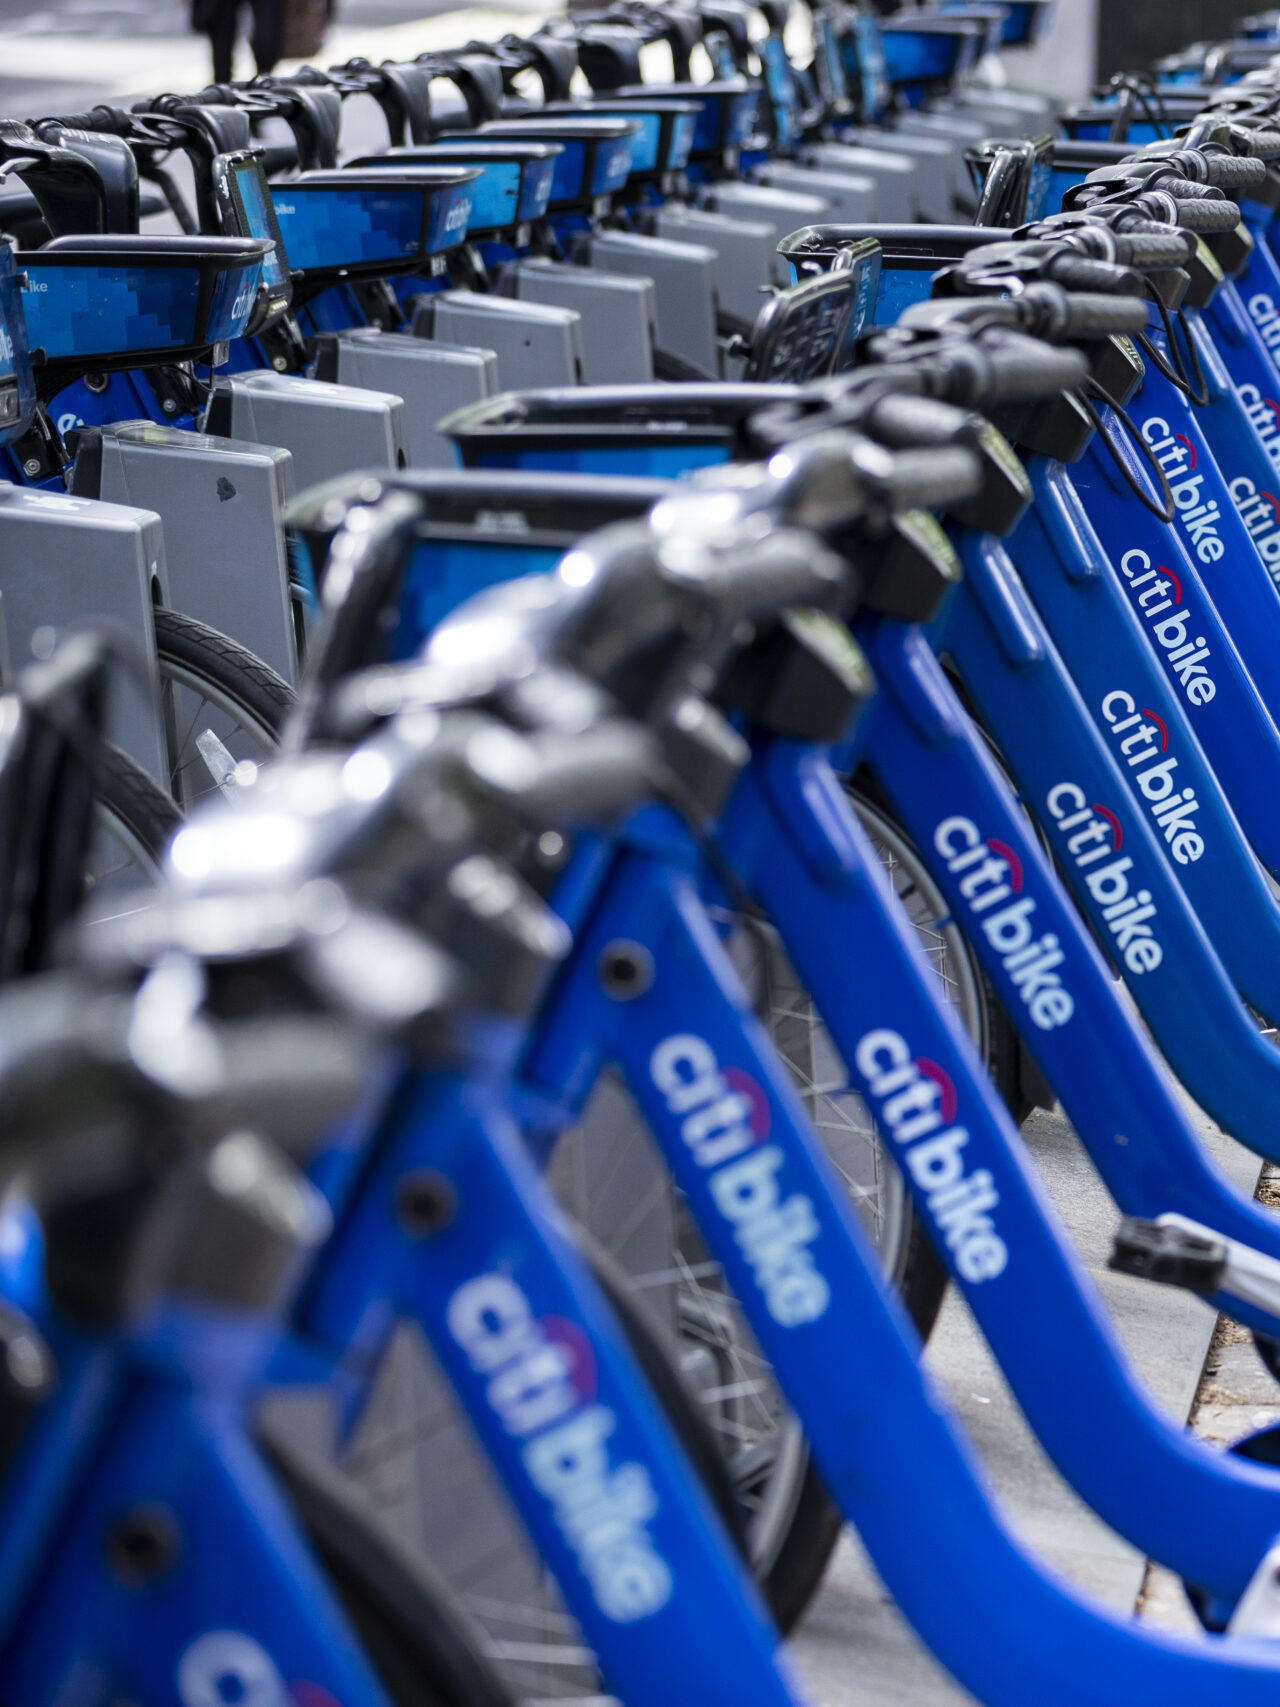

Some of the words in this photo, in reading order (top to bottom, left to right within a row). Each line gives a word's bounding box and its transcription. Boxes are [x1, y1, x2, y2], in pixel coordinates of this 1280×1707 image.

[1141, 417, 1197, 480] citi
[1169, 474, 1225, 564] bike
[1120, 548, 1182, 618] citi
[1152, 608, 1217, 707] bike
[1101, 690, 1169, 767] citi
[1135, 757, 1205, 865] bike
[933, 815, 1024, 913] citi
[981, 897, 1075, 1031] bike
[1046, 782, 1123, 867] citi
[1085, 856, 1163, 976] bike
[649, 1032, 772, 1168] citi
[855, 1028, 958, 1144] citi
[708, 1143, 832, 1328] bike
[905, 1125, 1009, 1284] bike
